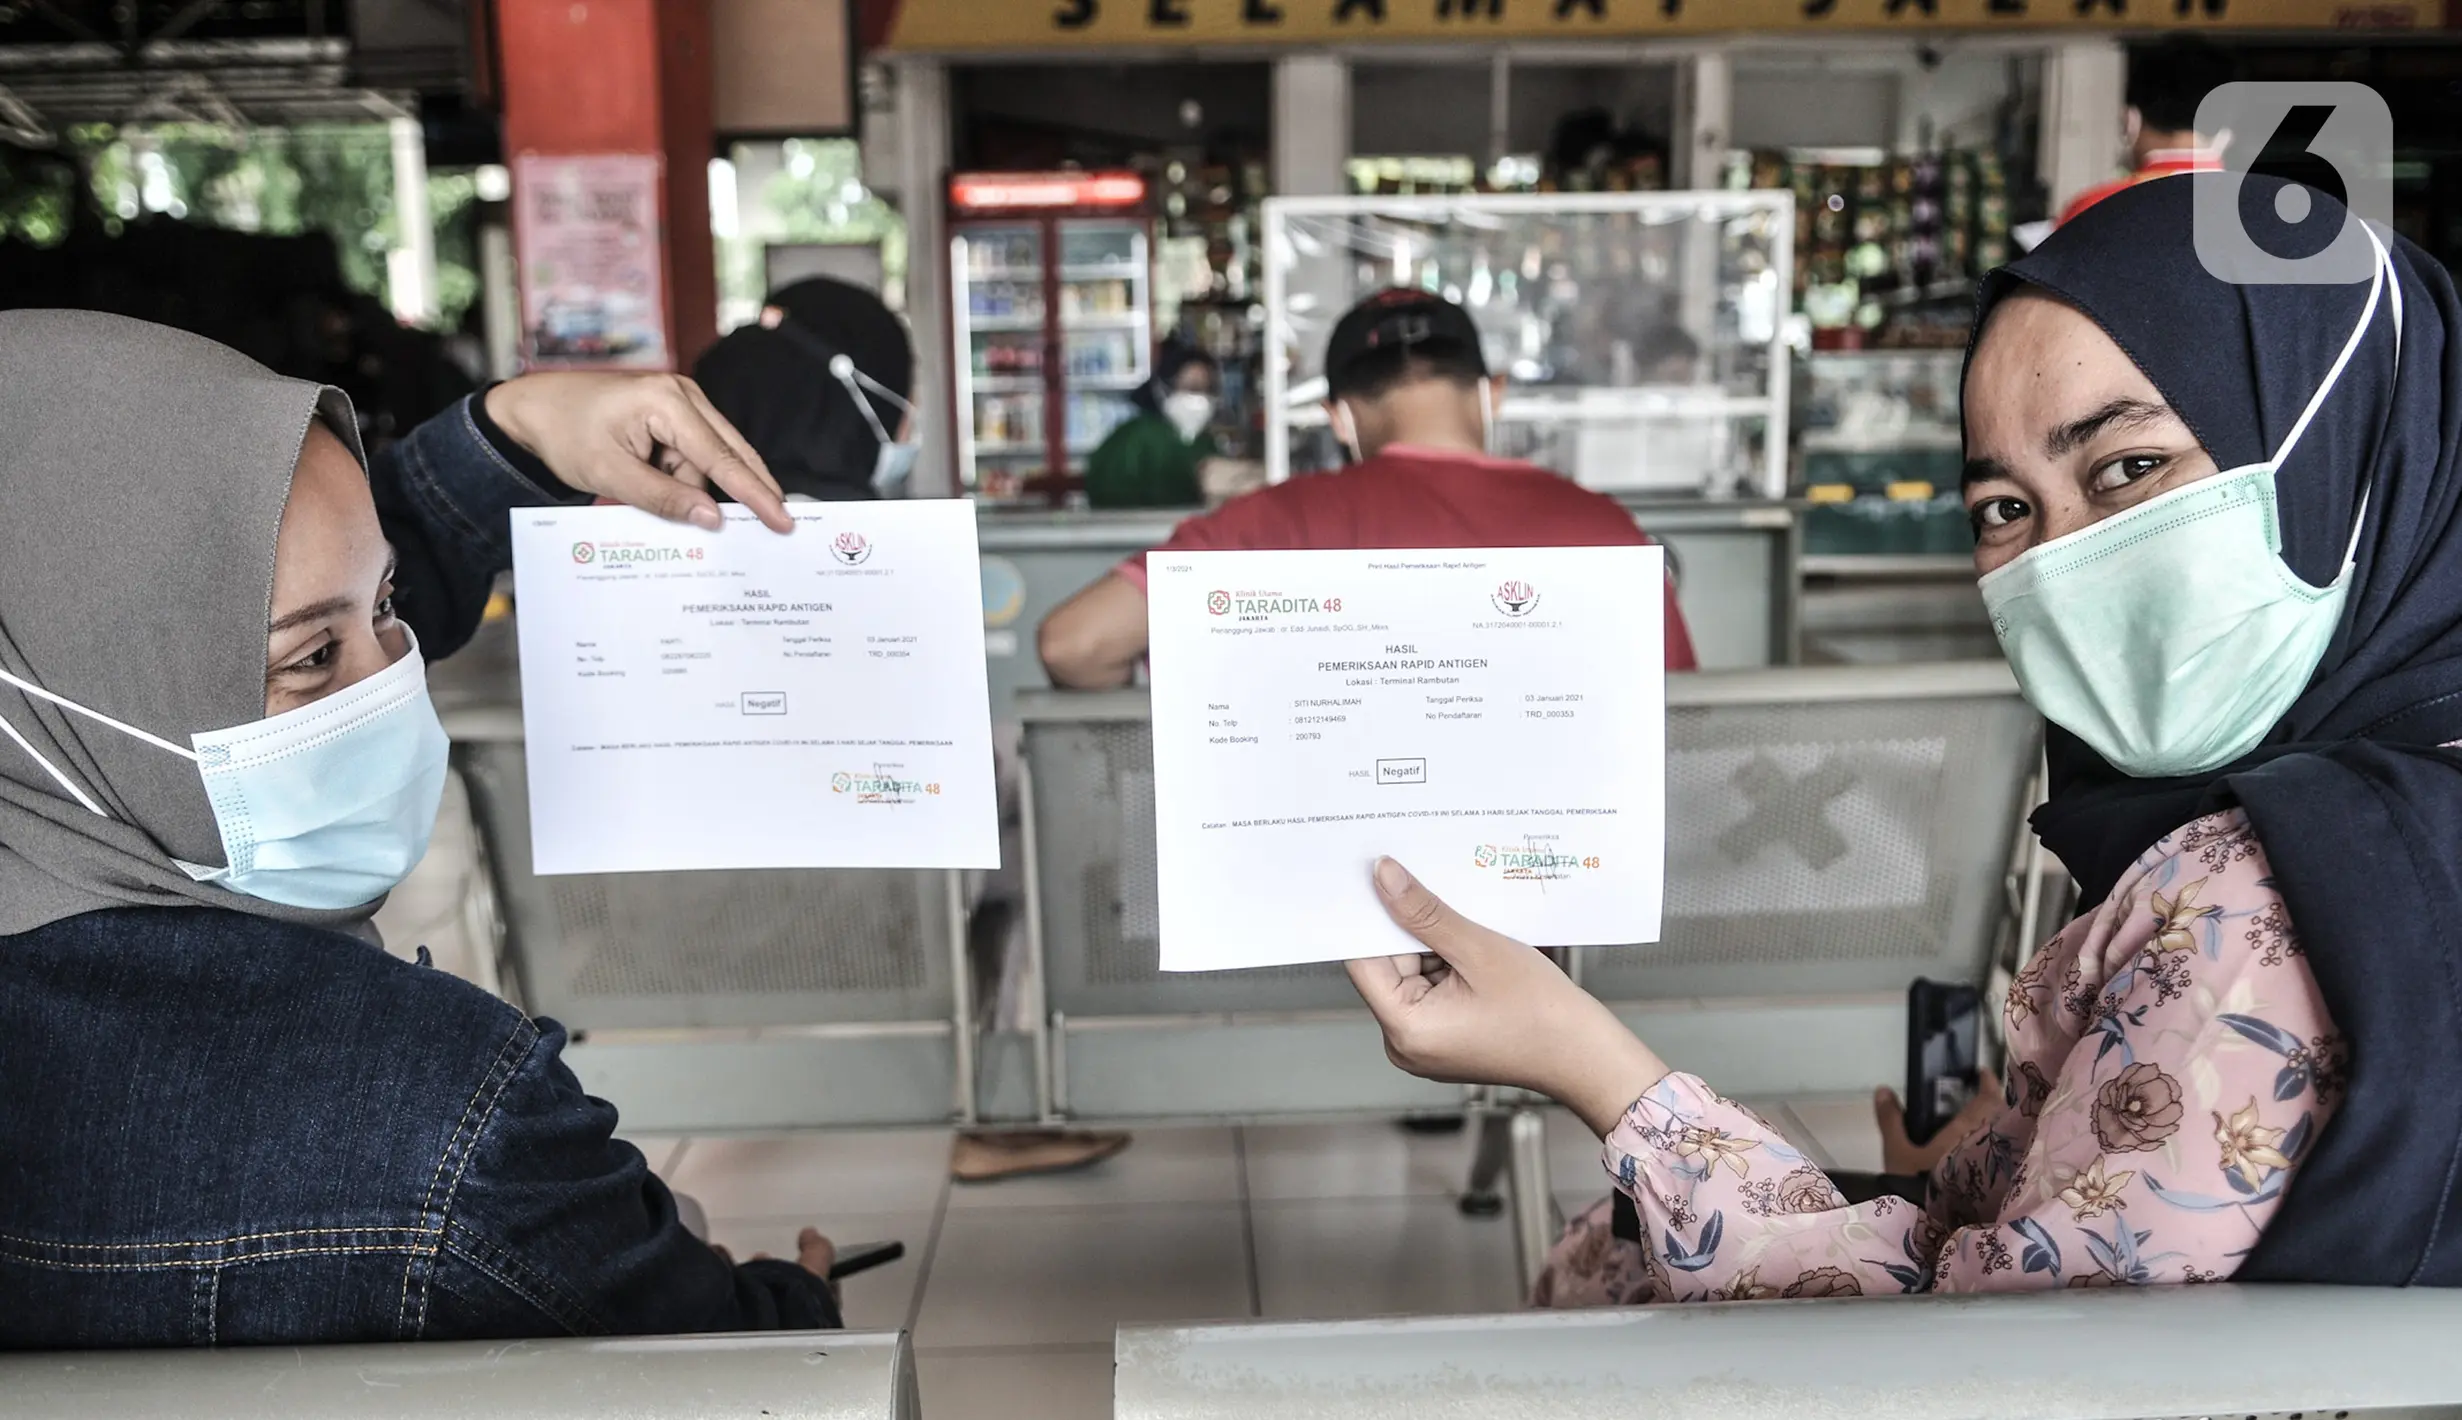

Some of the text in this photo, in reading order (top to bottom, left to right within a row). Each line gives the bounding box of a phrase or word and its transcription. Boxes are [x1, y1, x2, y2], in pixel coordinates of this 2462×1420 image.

[834, 531, 867, 552] ASKLIN
[599, 547, 704, 563] TARADITA 48
[1442, 561, 1461, 571] Rapid
[1462, 561, 1487, 571] Antigen
[743, 589, 772, 598] HASIL
[1235, 589, 1256, 597] Klinik
[1496, 579, 1534, 601] ASKLIN
[682, 603, 833, 613] PEMERIKSAAN RAPID ANTIGEN
[1235, 597, 1343, 614] TARADITA 48
[1385, 644, 1418, 654] HASIL
[1317, 658, 1488, 672] PEMERIKSAAN RAPID ANTIGEN
[1345, 675, 1460, 686] Lokasi Terminal Rambutan
[1294, 698, 1362, 708] SITI NURHALIMAH
[1425, 696, 1455, 704] Tanggal
[1525, 694, 1584, 702] 03 Januari 2021
[747, 700, 781, 710] Negatif
[1208, 703, 1230, 711] Nama
[1425, 711, 1483, 720] No Pendaftaran
[1525, 710, 1574, 719] TRD_000353
[1209, 735, 1259, 745] Kode Booking
[1295, 732, 1322, 741] 200793
[1348, 770, 1371, 778] HASIL
[1382, 766, 1421, 778] Negatif
[853, 780, 941, 795] TARADITA 48
[1232, 820, 1252, 828] MASA
[1253, 818, 1286, 827] BERLAKU
[1286, 817, 1306, 825] HASIL
[1307, 814, 1354, 824] PEMERIKSAAN
[1355, 812, 1376, 821] RAPID
[1377, 811, 1407, 820] ANTIGEN
[1407, 810, 1439, 818] COVID-19
[1450, 809, 1480, 817] SELAMA
[1530, 808, 1564, 816] TANGGAL
[1565, 808, 1618, 816] PEMERIKSAAN
[1500, 853, 1600, 869] TARADITA 48
